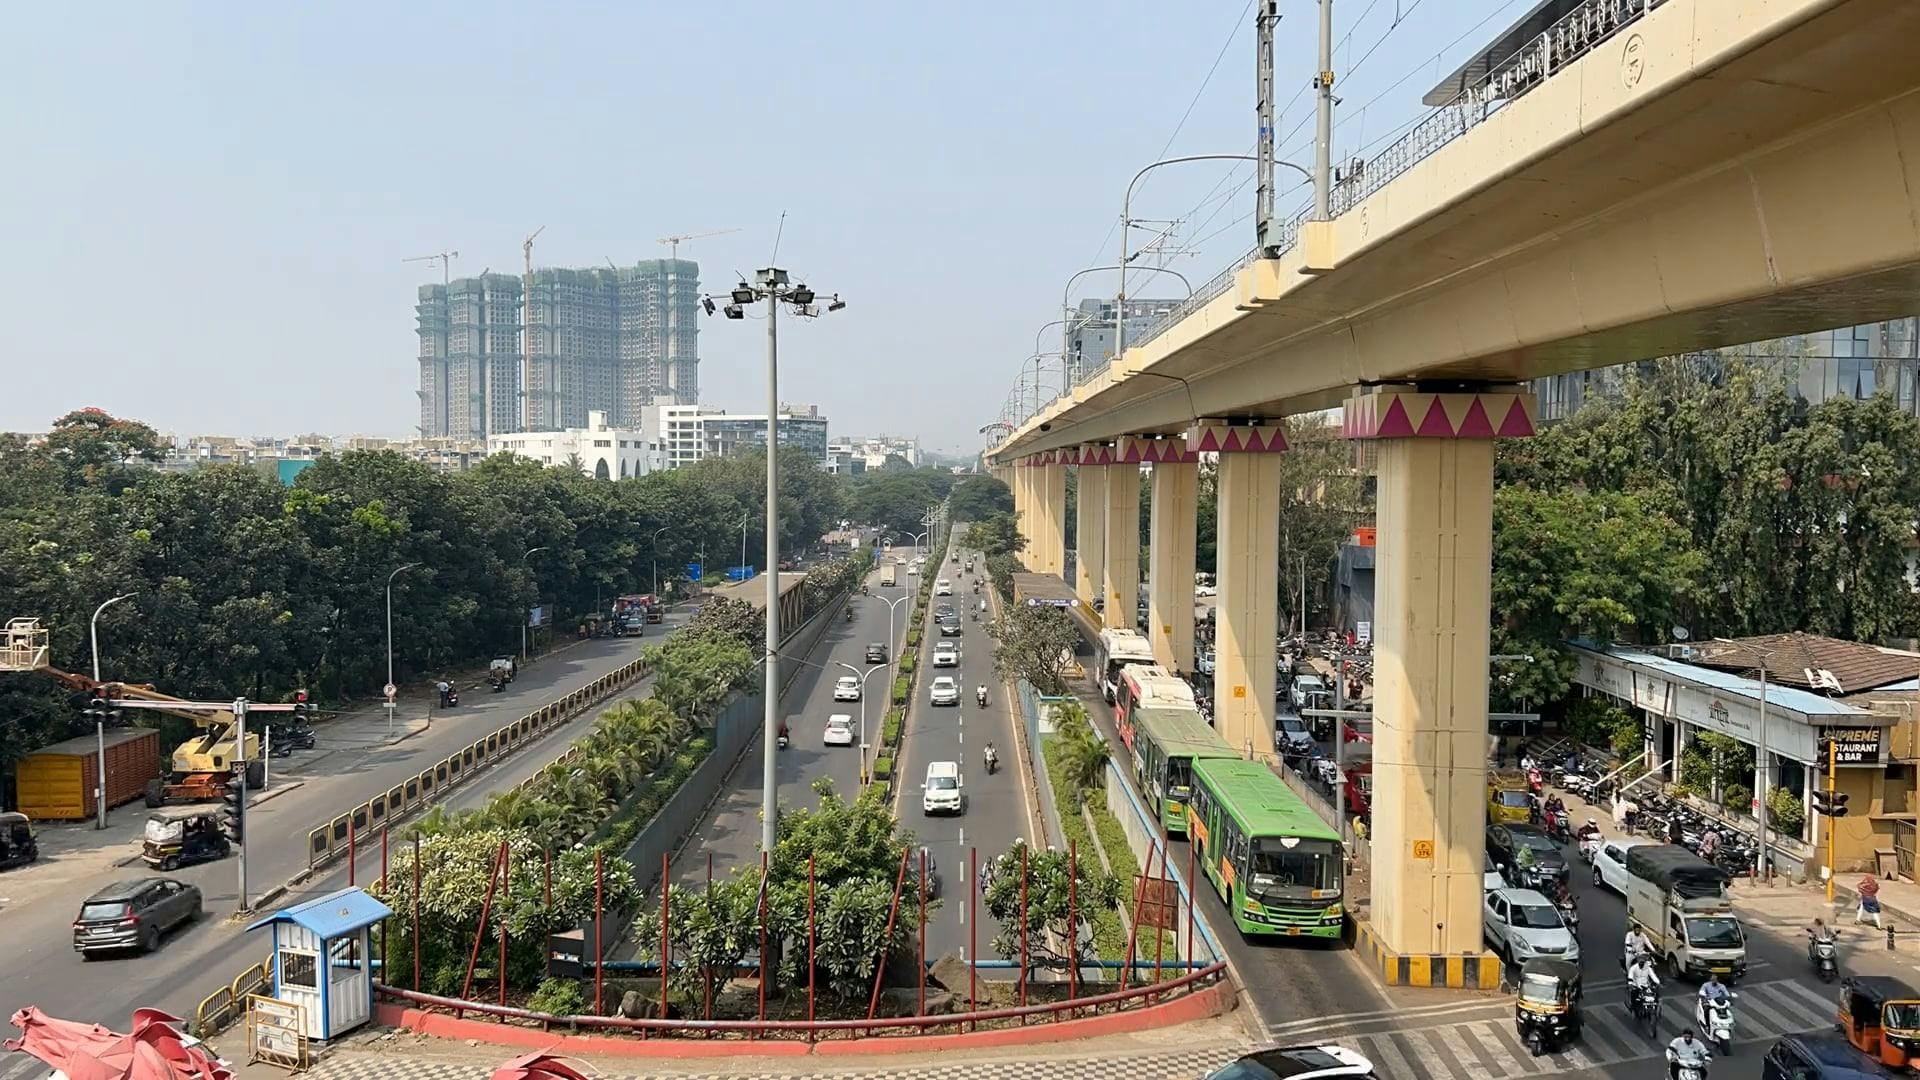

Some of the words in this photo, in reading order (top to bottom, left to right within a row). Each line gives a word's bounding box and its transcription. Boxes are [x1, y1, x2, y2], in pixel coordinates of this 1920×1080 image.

[1834, 743, 1878, 753] STAURANT
[1836, 753, 1844, 761] &
[1845, 752, 1862, 761] BAR
